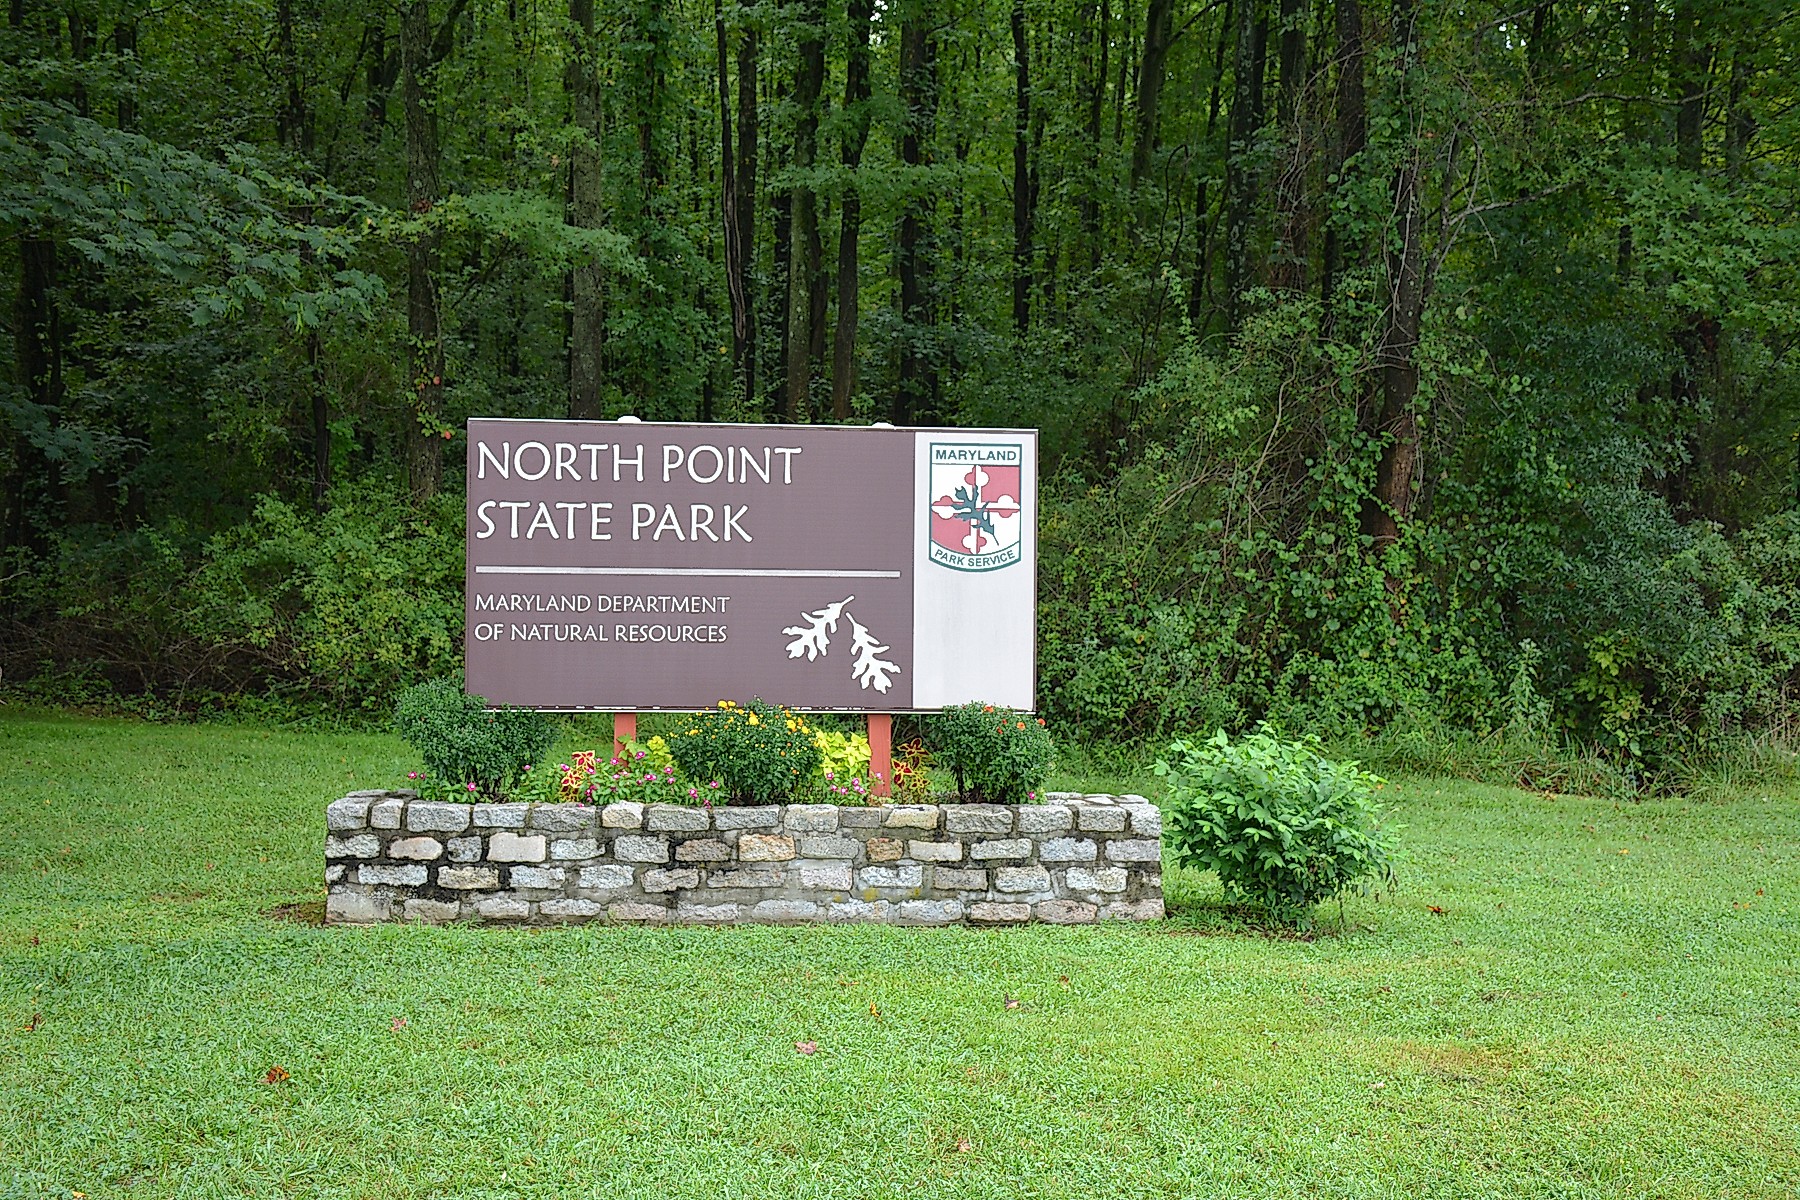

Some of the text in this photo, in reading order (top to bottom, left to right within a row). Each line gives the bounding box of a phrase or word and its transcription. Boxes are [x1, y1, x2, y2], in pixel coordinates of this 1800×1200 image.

[476, 441, 803, 485] NORTH POINT
[935, 449, 1017, 461] MARYLAND
[476, 500, 753, 543] STATE PARK
[934, 548, 1016, 567] PARK SERVICE
[475, 593, 731, 613] MARYLAND DEPARTMENT
[474, 623, 728, 643] OF NATURAL RESOURCES
